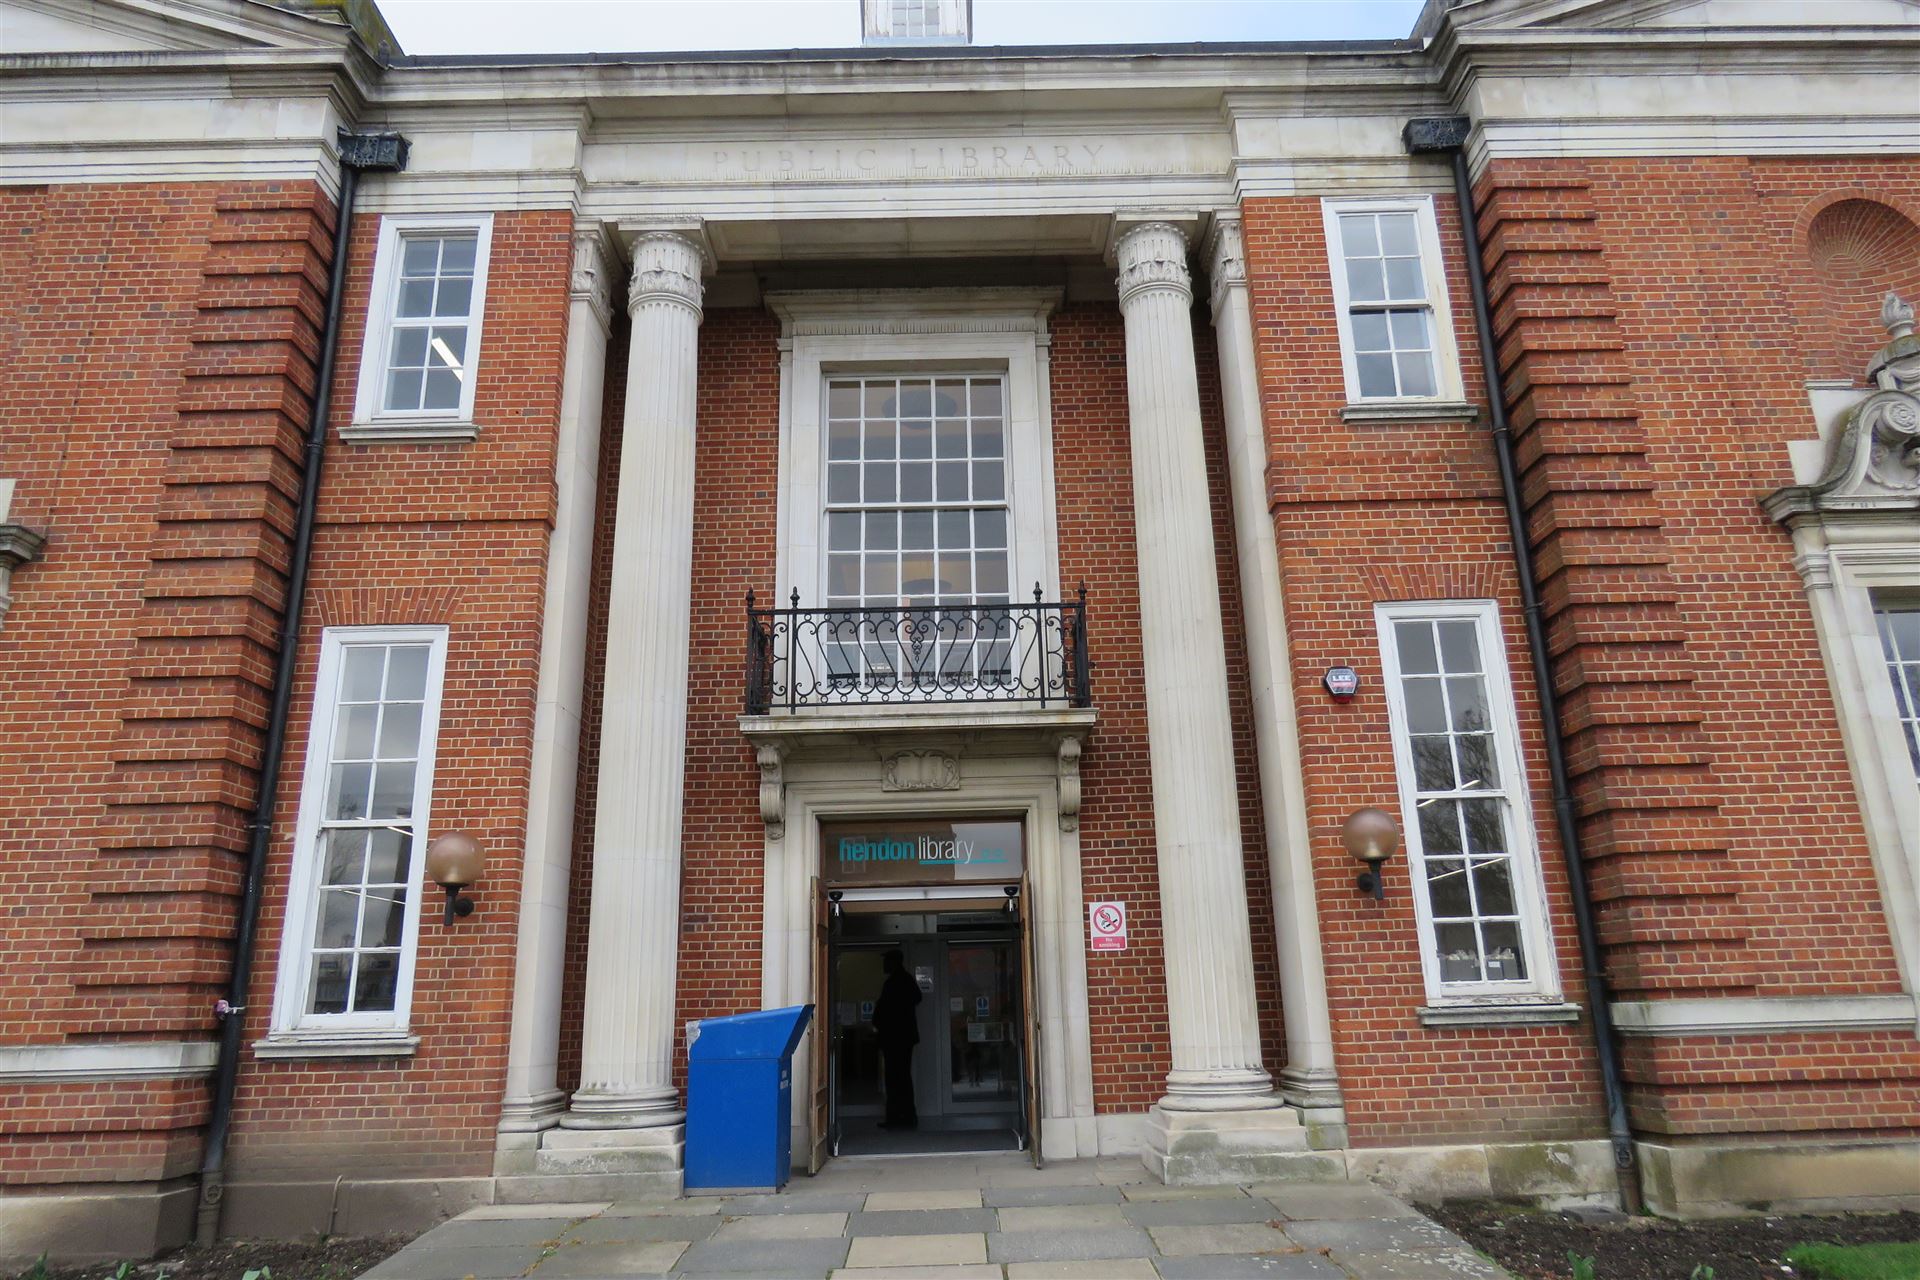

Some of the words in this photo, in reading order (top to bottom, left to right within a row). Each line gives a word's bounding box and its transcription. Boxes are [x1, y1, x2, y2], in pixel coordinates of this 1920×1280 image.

[713, 149, 877, 172] PUBLIC
[910, 145, 1104, 169] LIBRARY
[840, 837, 915, 861] hendon
[918, 836, 975, 864] library
